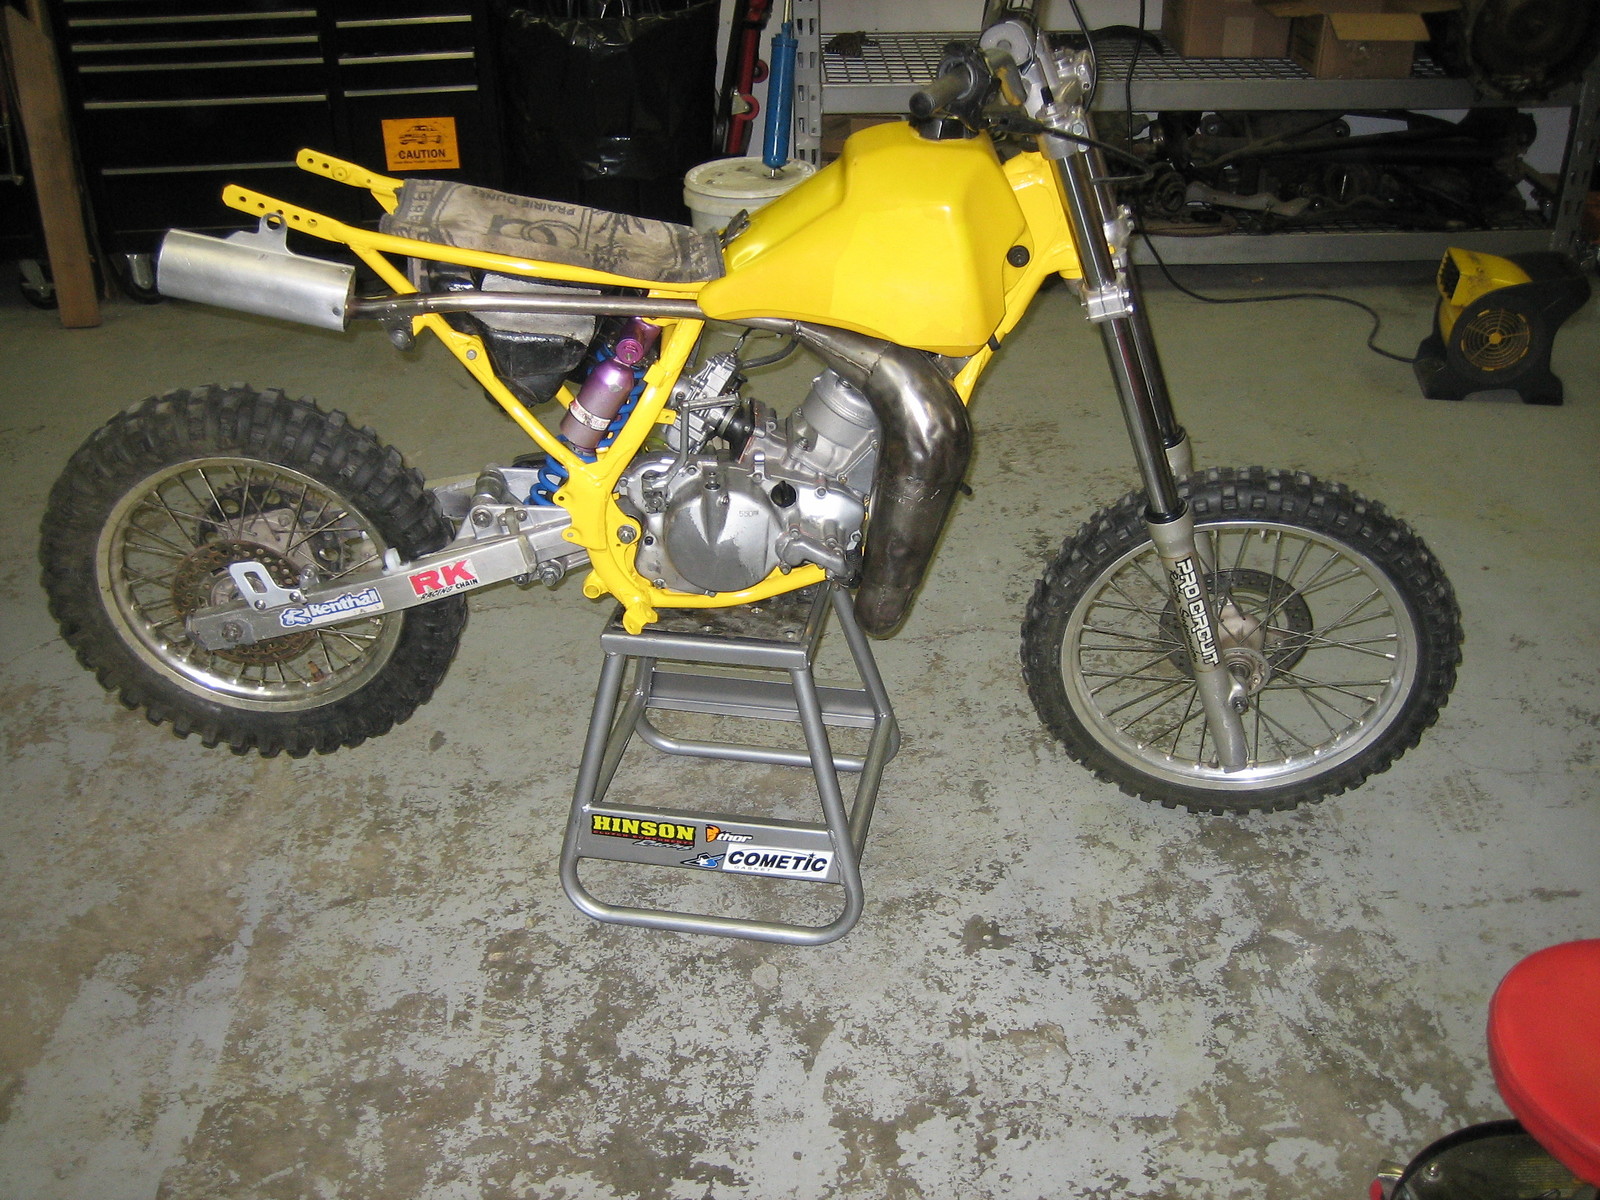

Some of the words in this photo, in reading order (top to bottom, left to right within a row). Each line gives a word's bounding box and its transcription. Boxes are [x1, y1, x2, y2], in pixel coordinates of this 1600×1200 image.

[398, 149, 446, 159] CAUTION
[521, 199, 575, 216] PRAIRIE
[409, 559, 476, 595] RK
[420, 586, 453, 600] RACING
[455, 579, 478, 589] CHAIN
[1175, 556, 1201, 600] PRO
[1188, 599, 1220, 666] CIRCUIT
[593, 815, 695, 841] HINSON
[716, 830, 753, 843] thor
